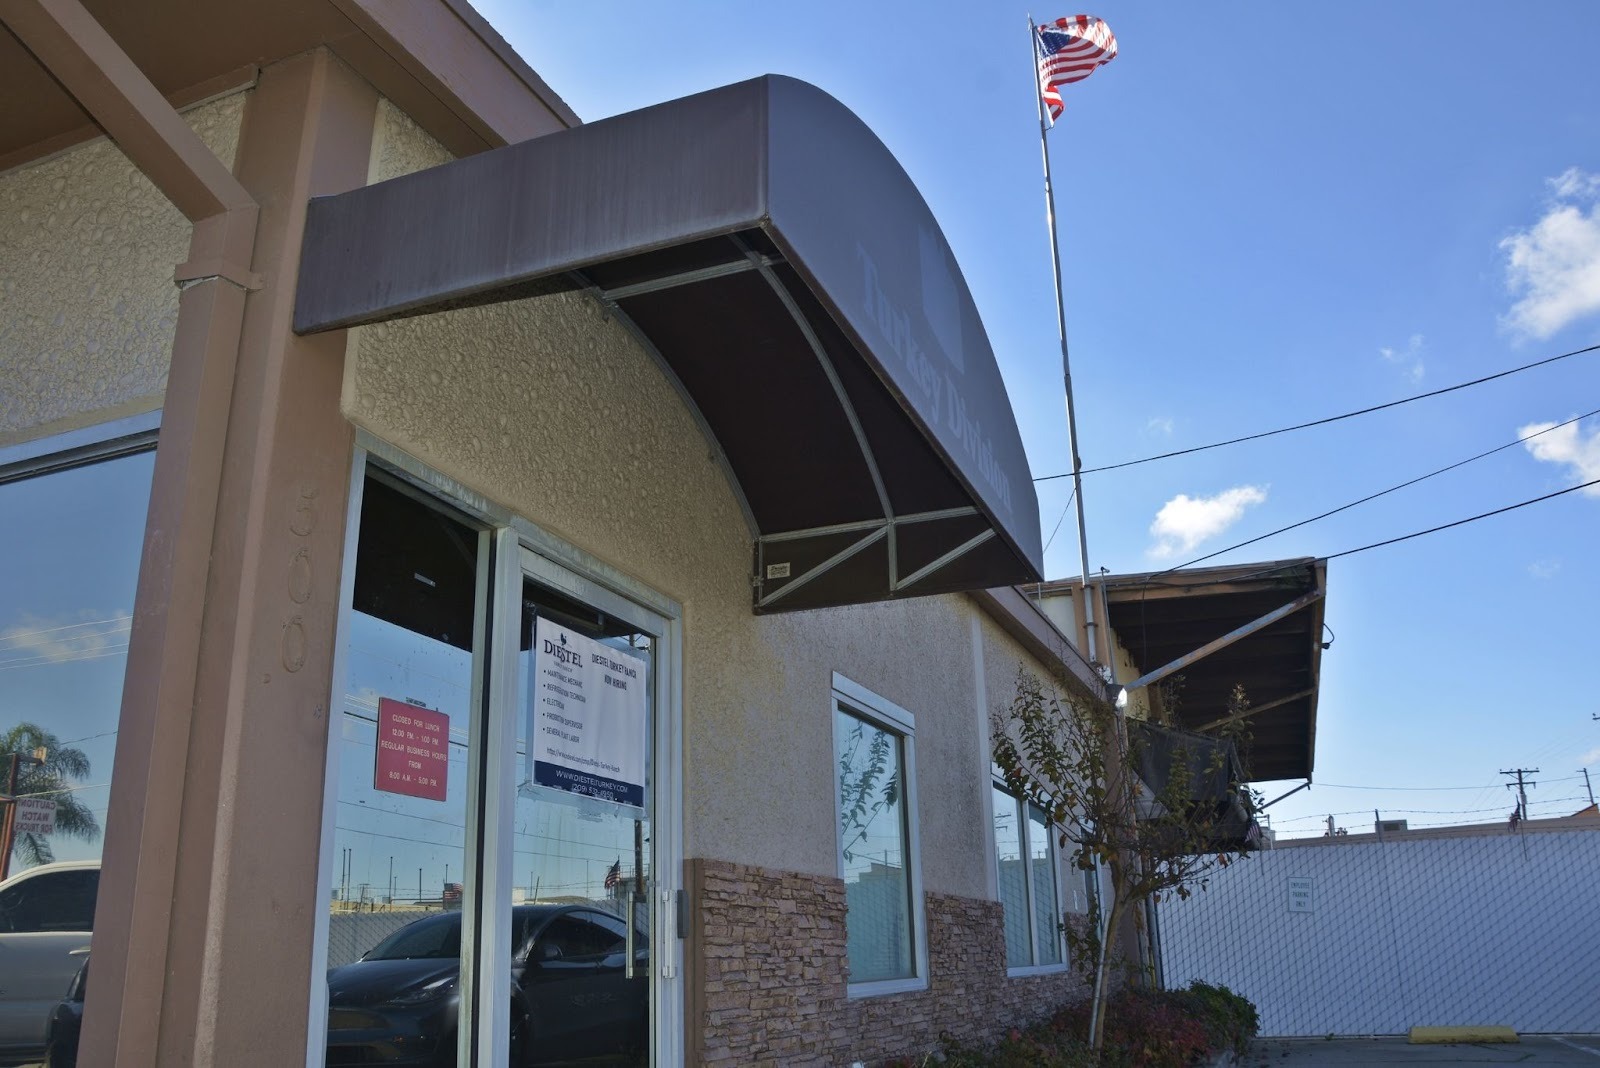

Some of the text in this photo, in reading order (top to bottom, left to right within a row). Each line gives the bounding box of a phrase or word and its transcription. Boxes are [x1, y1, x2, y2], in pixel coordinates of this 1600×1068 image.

[857, 240, 1013, 514] Turkey Division
[543, 639, 583, 668] DIESTEL
[591, 653, 609, 668] DIESTEL
[609, 660, 624, 673] TURKEY
[612, 677, 627, 691] HIRING
[392, 713, 440, 733] CLOSED FOR LUNCH
[381, 740, 447, 762] REGULAR BUSINESS HOURS
[408, 760, 422, 770] FROM
[571, 783, 588, 794] (209)
